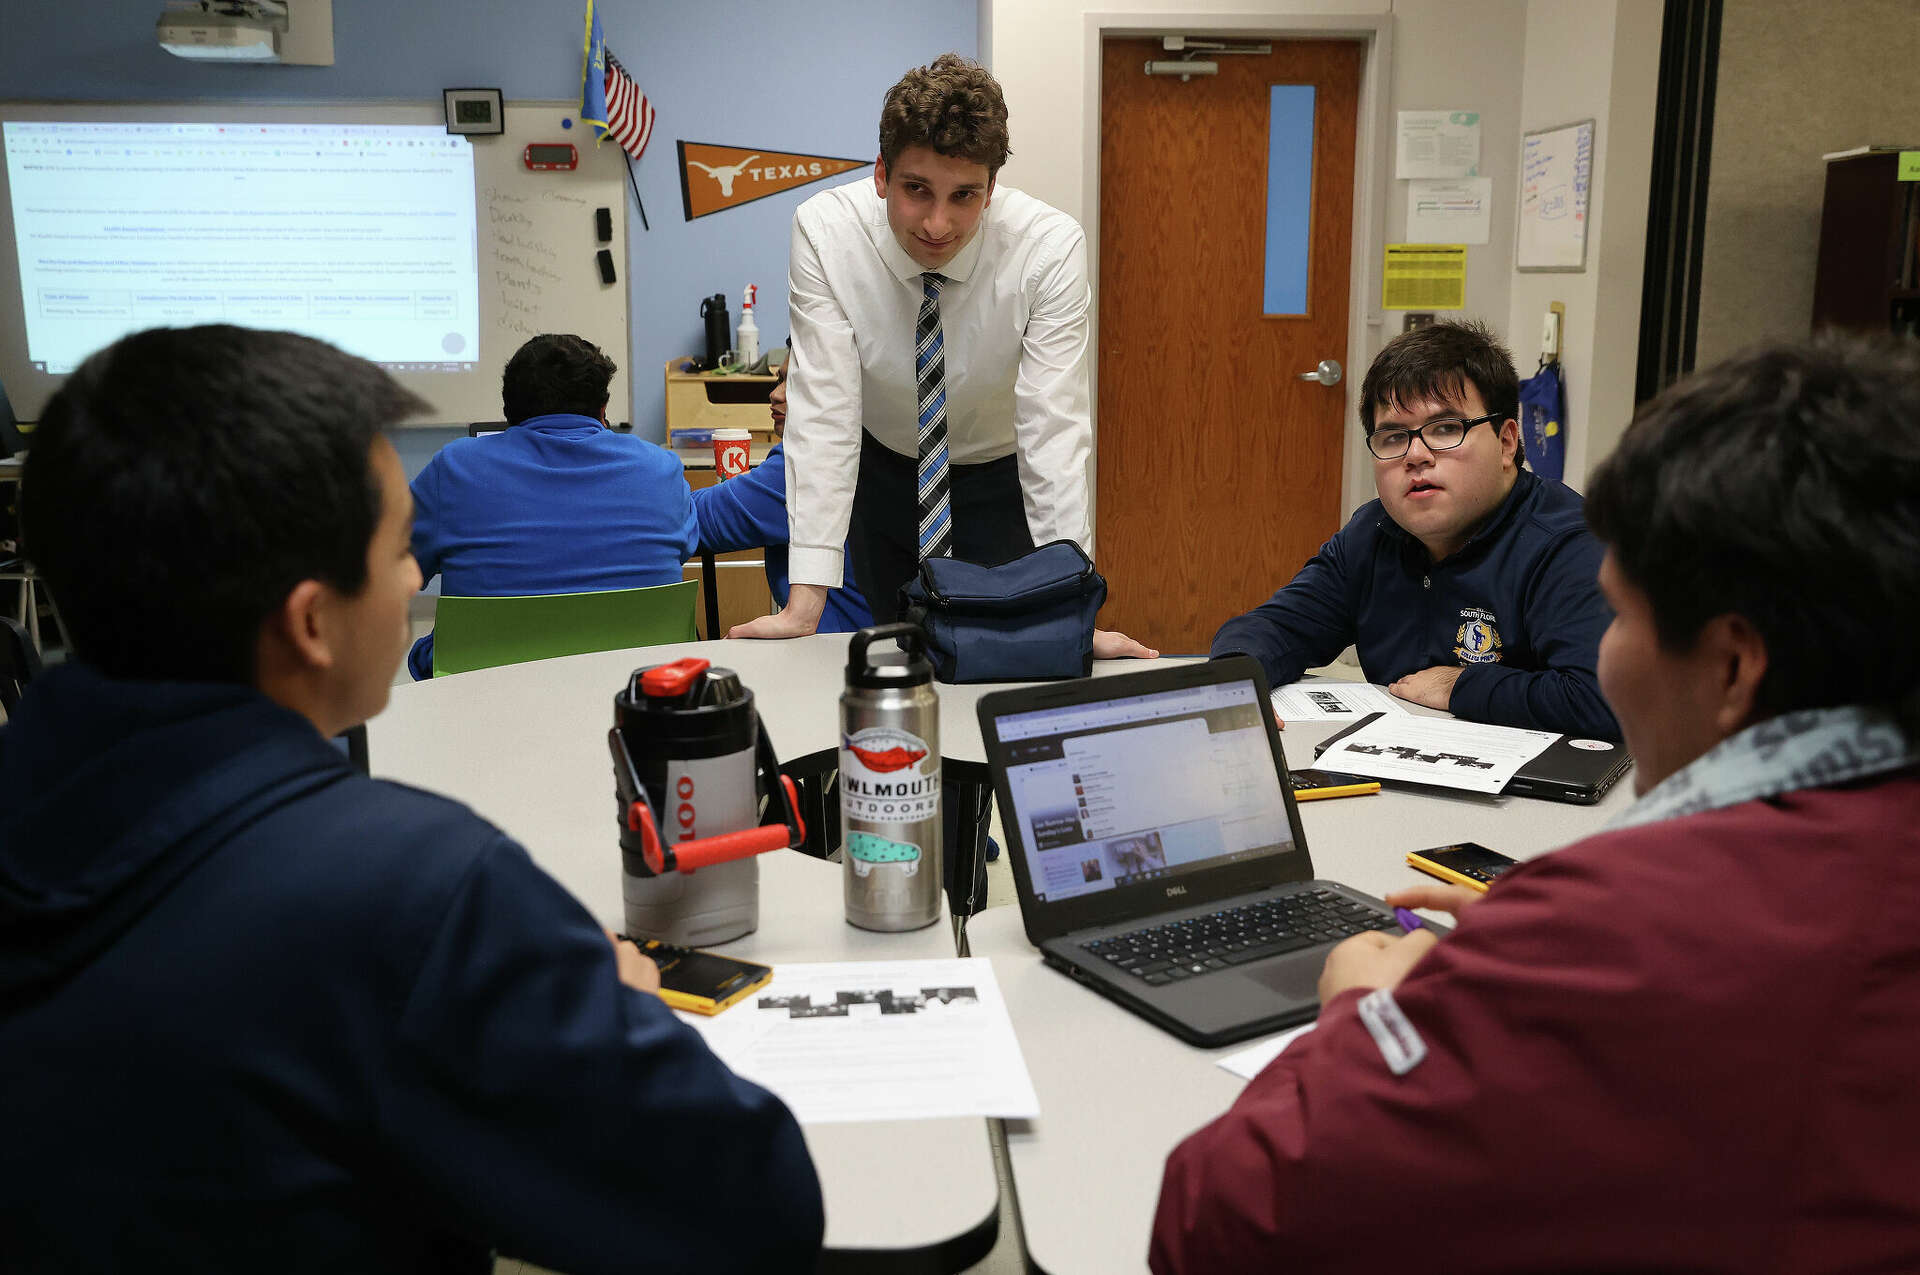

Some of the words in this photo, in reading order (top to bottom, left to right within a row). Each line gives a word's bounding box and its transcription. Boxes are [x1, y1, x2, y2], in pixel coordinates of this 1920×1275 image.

[749, 162, 822, 182] TEXAS
[729, 452, 748, 472] K
[1460, 609, 1480, 619] SOUTH
[846, 799, 935, 814] UTDOORS
